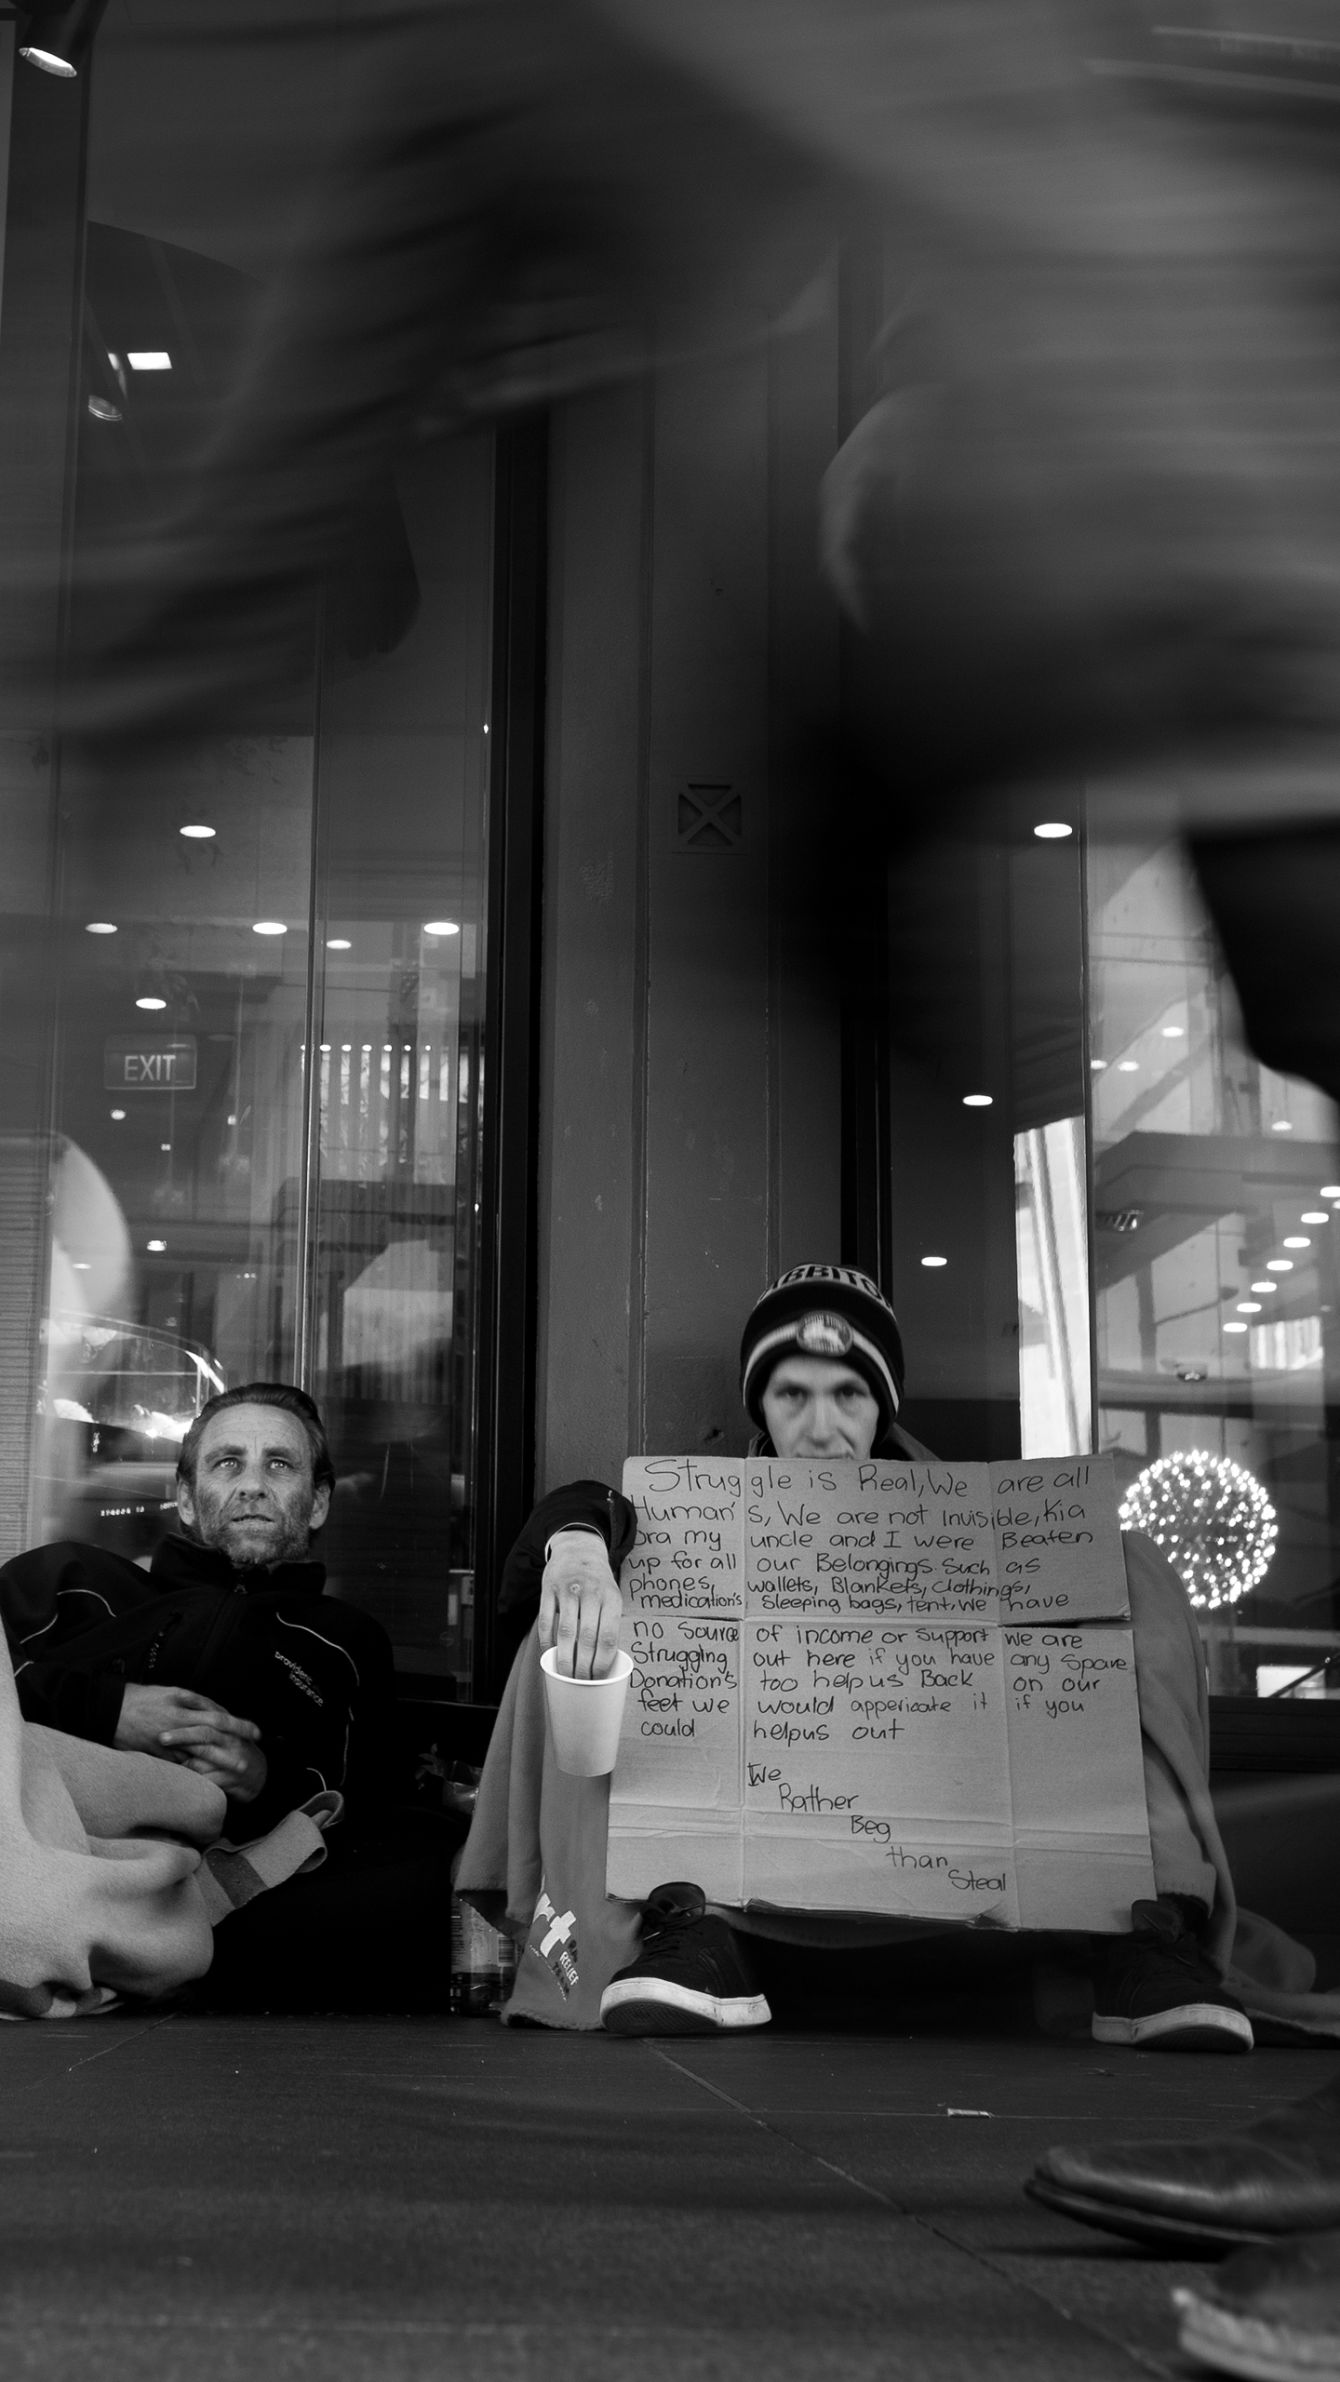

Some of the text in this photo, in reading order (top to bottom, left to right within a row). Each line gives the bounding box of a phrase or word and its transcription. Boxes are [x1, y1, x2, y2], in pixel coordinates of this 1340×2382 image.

[124, 1054, 177, 1081] EXIT
[809, 1470, 838, 1491] is
[997, 1474, 1044, 1495] are
[1053, 1465, 1090, 1488] all
[777, 1501, 821, 1526] We
[837, 1509, 879, 1525] are
[889, 1504, 928, 1526] not
[1043, 1499, 1086, 1522] Kia
[685, 1530, 721, 1551] my
[751, 1530, 813, 1548] uncle
[829, 1532, 875, 1549] and
[883, 1530, 902, 1548] I
[914, 1534, 975, 1550] were
[1002, 1530, 1093, 1550] Beaten
[628, 1557, 661, 1574] up
[671, 1551, 703, 1569] for
[711, 1553, 736, 1569] all
[757, 1558, 801, 1572] our
[1006, 1558, 1041, 1574] as
[748, 1576, 819, 1595] wallets,
[1008, 1594, 1070, 1612] have
[634, 1621, 664, 1639] no
[756, 1624, 783, 1642] of
[797, 1625, 873, 1645] income
[881, 1631, 908, 1644] or
[1042, 1634, 1083, 1649] are
[753, 1649, 791, 1667] out
[807, 1649, 856, 1667] here
[869, 1648, 886, 1664] if
[896, 1654, 937, 1675] you
[950, 1650, 995, 1666] have
[1010, 1653, 1050, 1675] any
[760, 1670, 798, 1692] too
[921, 1669, 974, 1688] Back
[1013, 1676, 1043, 1692] on
[1062, 1677, 1101, 1692] our
[638, 1688, 683, 1712] feet
[692, 1697, 730, 1713] we
[758, 1696, 834, 1715] would
[973, 1691, 988, 1710] it
[1015, 1694, 1031, 1711] if
[1045, 1700, 1085, 1719] you
[641, 1719, 695, 1737] could
[851, 1718, 905, 1740] out
[779, 1782, 859, 1812] Rather
[851, 1815, 891, 1844] Beg
[886, 1846, 948, 1869] than
[559, 1951, 580, 1986] RELIEF
